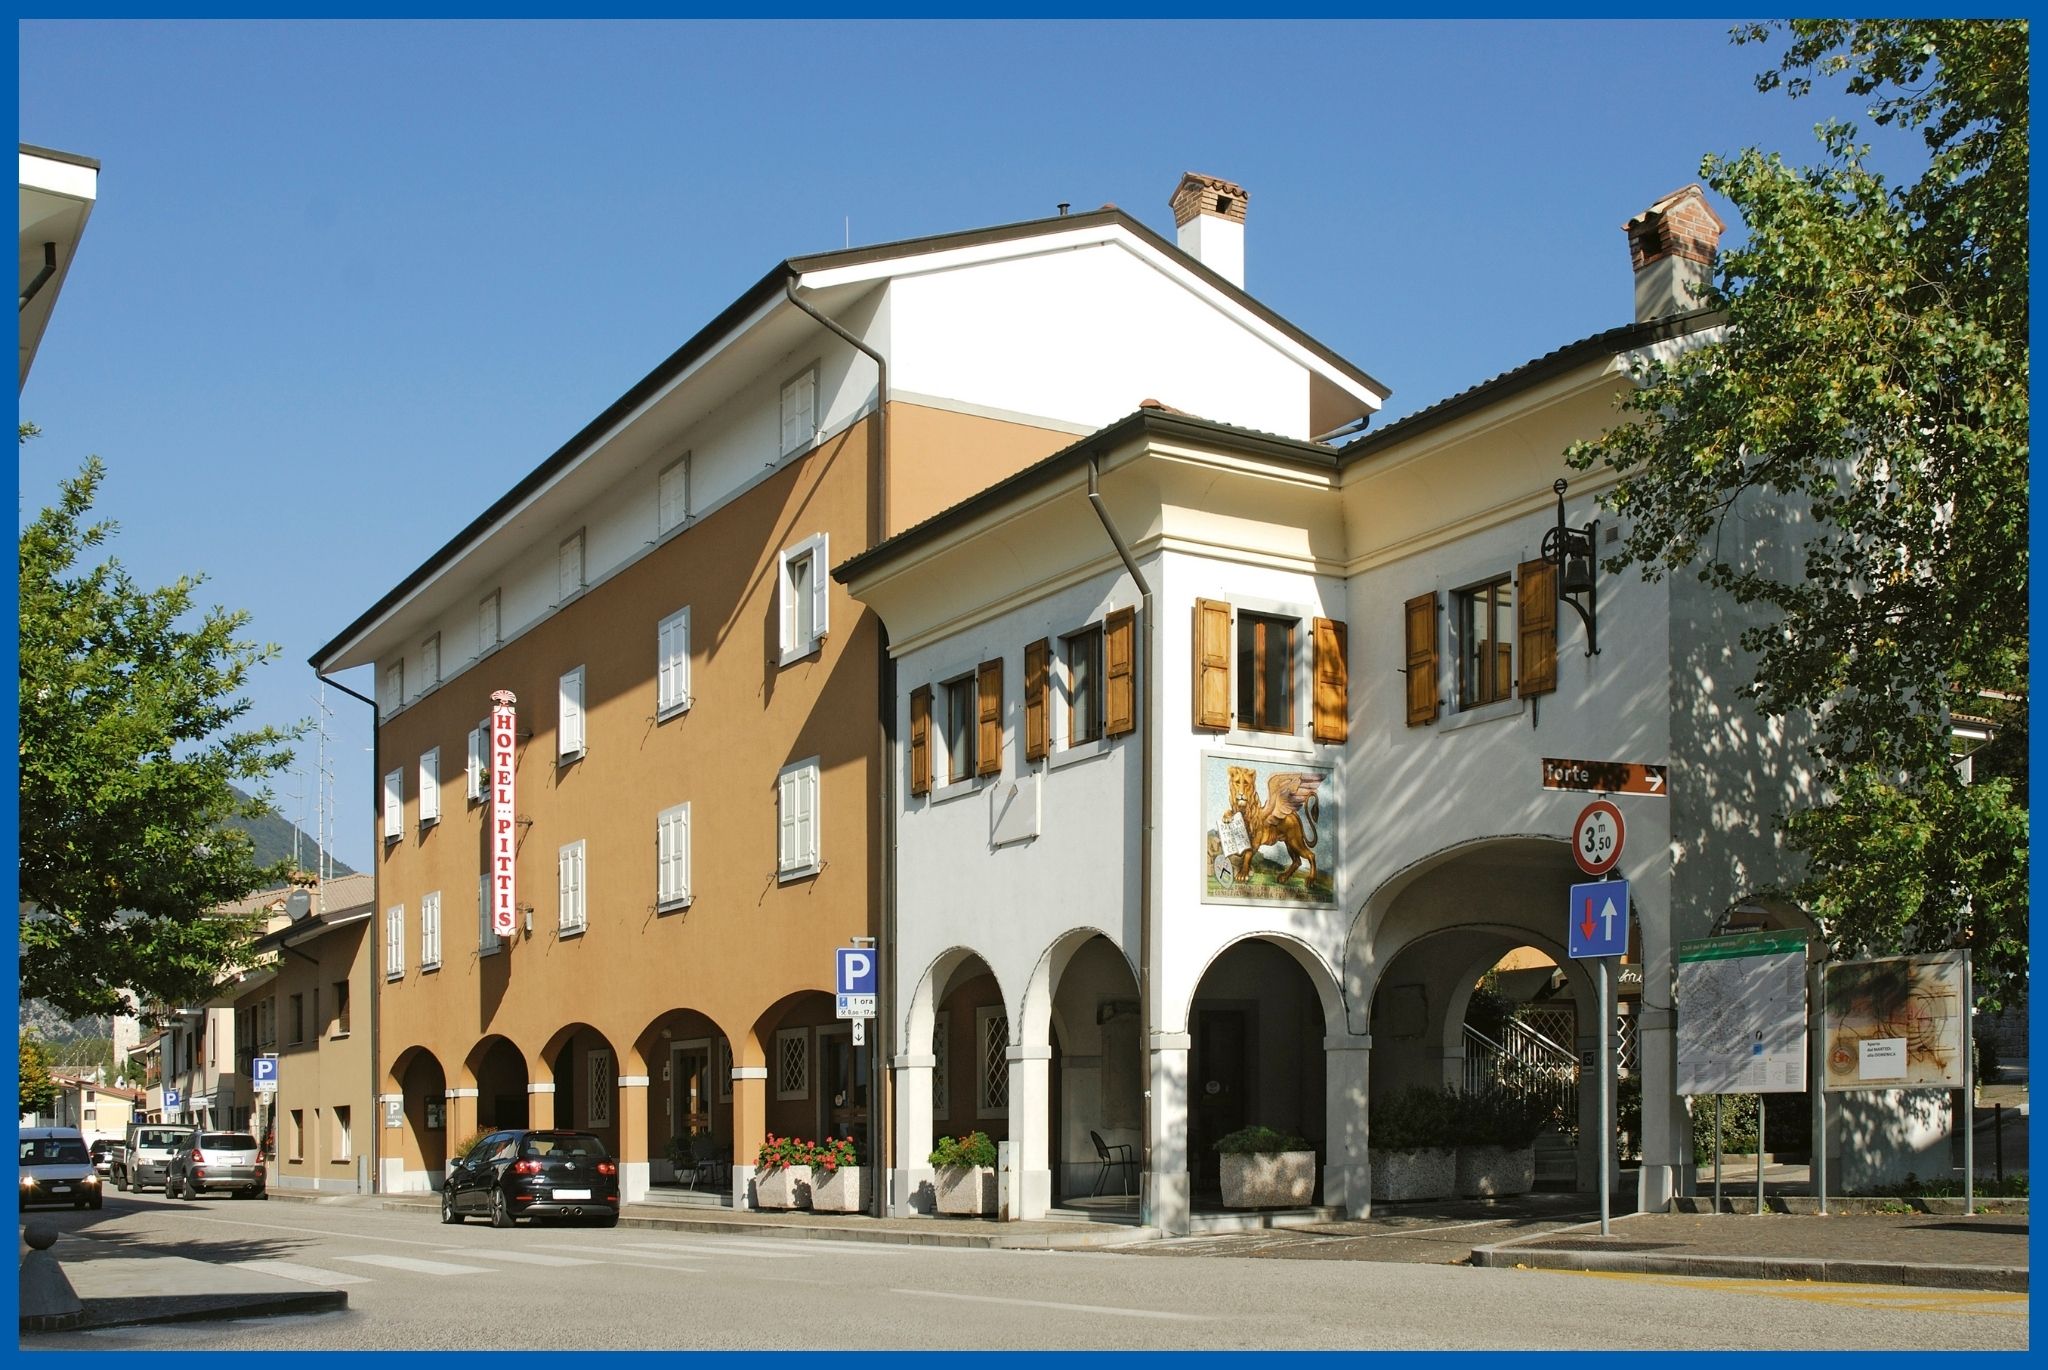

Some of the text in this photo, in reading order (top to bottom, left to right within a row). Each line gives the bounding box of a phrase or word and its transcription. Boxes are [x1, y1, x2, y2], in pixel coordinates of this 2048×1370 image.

[1547, 764, 1589, 782] forte
[497, 714, 512, 927] HOTEL PITTIS
[845, 953, 871, 990] P
[258, 1061, 273, 1079] P
[166, 1093, 177, 1106] P
[390, 1102, 400, 1115] P
